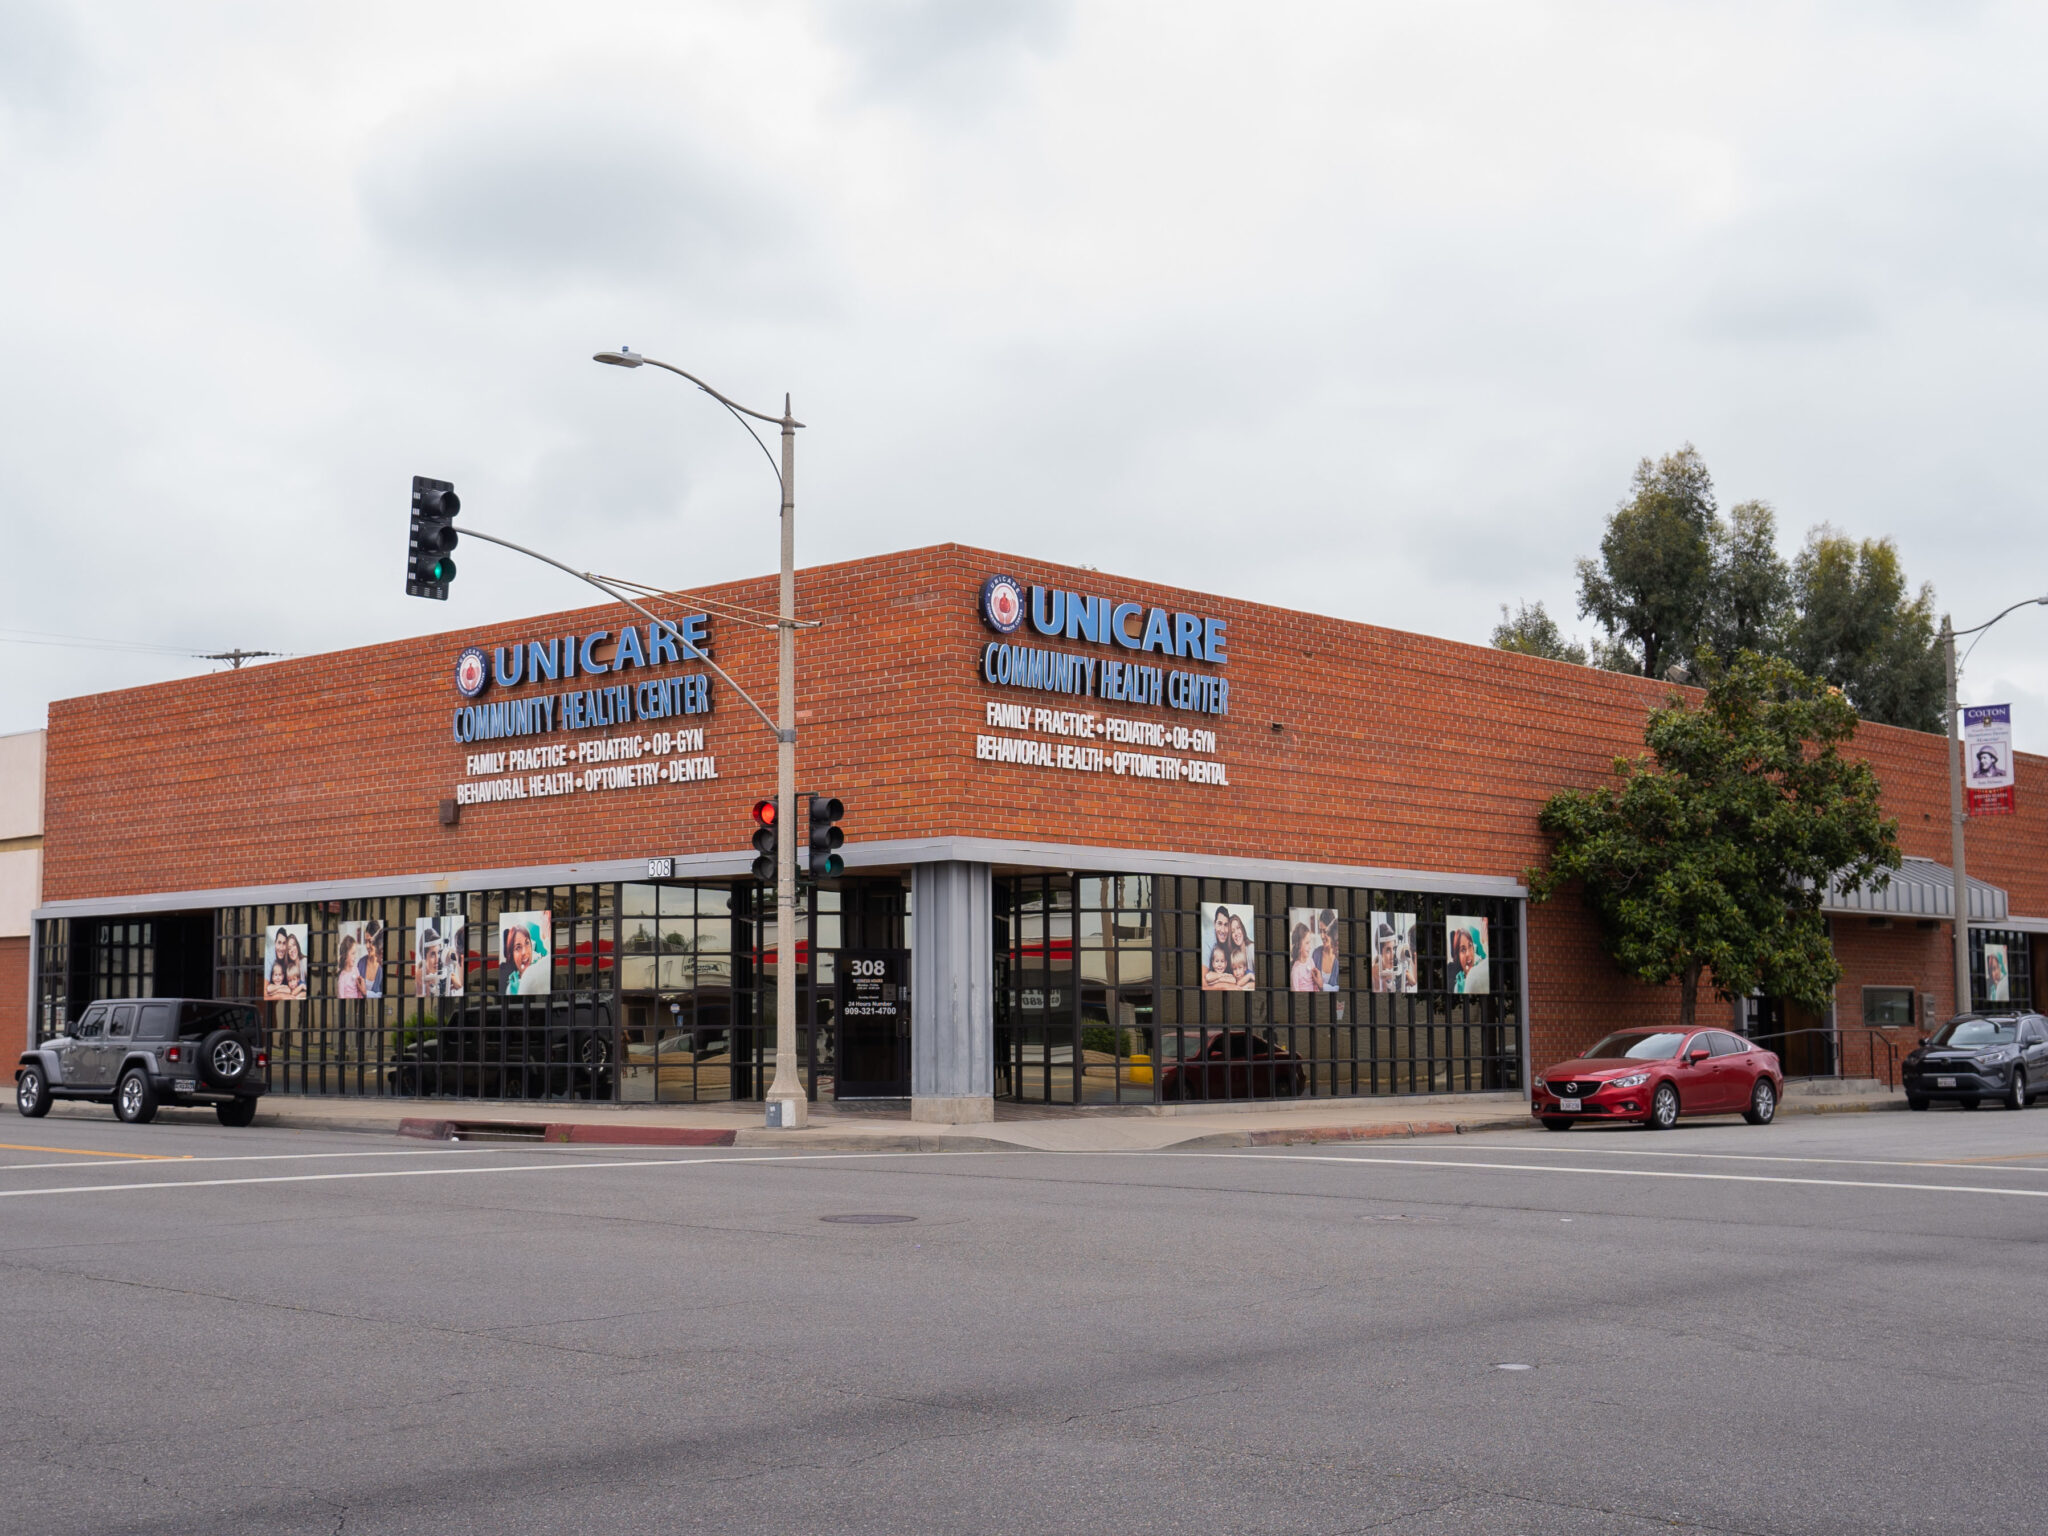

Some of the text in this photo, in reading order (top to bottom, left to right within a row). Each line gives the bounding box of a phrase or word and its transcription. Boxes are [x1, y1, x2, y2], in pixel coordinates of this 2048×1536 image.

[494, 613, 709, 687] UNICARE
[1032, 585, 1228, 664] UNICARE
[984, 641, 1229, 715] COMMUNITY HEALTH CENTER
[453, 674, 709, 743] COMMUNITY HEALTH CENTER
[986, 701, 1216, 753] FAMILY PRACTICE PEDIATRIC OB-GYN
[466, 728, 704, 776] FAMILY PRACTICE PEDIATRIC OB-GYN
[976, 734, 1229, 786] BEHAVIORAL HEALTH OPTOMETRY DENTAL
[457, 756, 718, 805] BEHAVIORAL HEALTH OPTOMETRY DENTAL
[649, 860, 670, 876] 308
[851, 960, 885, 976] 308
[844, 1007, 897, 1015] 909-321-4700
